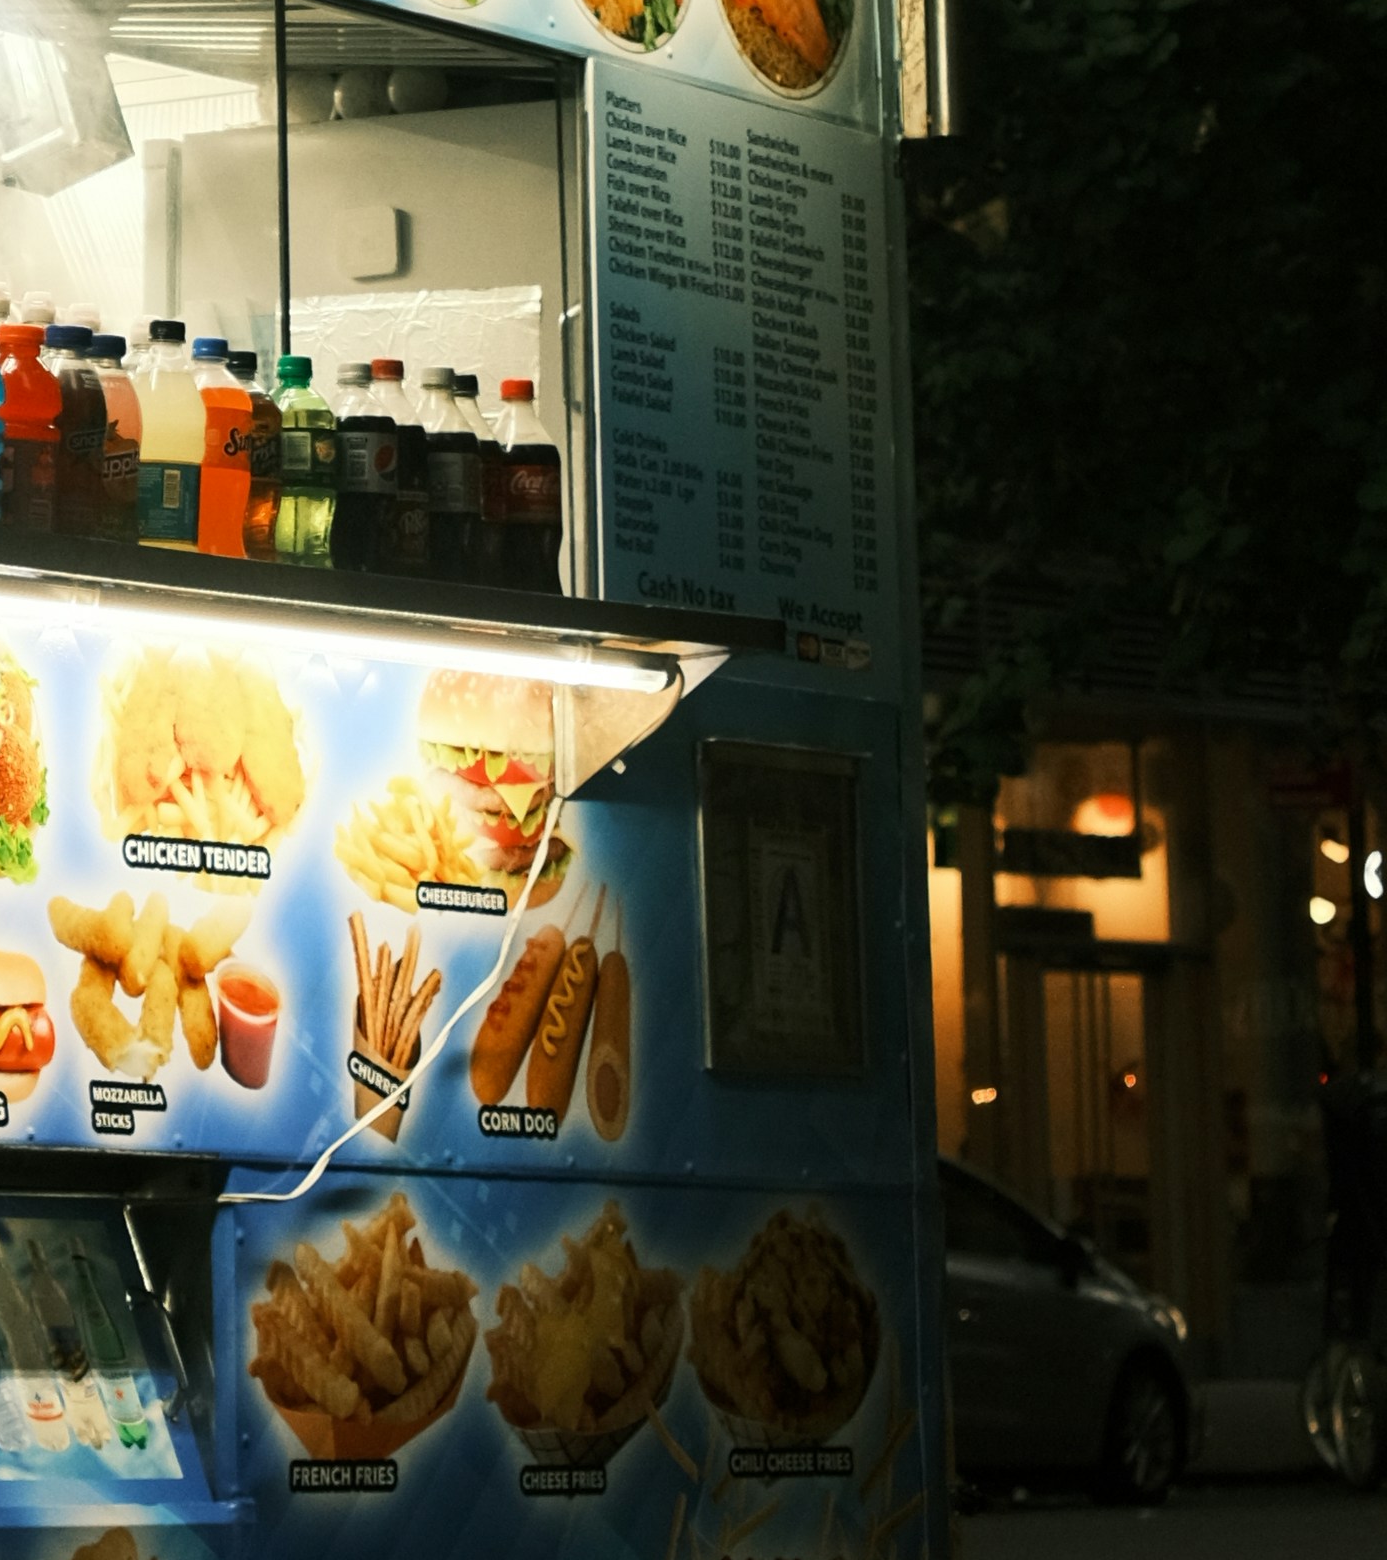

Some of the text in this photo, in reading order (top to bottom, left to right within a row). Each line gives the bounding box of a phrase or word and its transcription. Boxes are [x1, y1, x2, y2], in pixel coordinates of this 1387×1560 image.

[606, 111, 643, 135] Chicken
[637, 570, 736, 611] Cash No tax
[777, 596, 865, 636] We Accept
[125, 839, 269, 874] CHICKEN TENDER
[418, 886, 505, 910] CHEESEBURGER
[93, 1086, 164, 1106] MOZZARELLA
[95, 1113, 132, 1130] STICKS
[481, 1111, 556, 1134] CORN DOG
[730, 1451, 852, 1474] CHILI CHEESE FRIES
[292, 1464, 396, 1488] FRENCH FRIES
[523, 1470, 605, 1491] CHEESE FRIES
